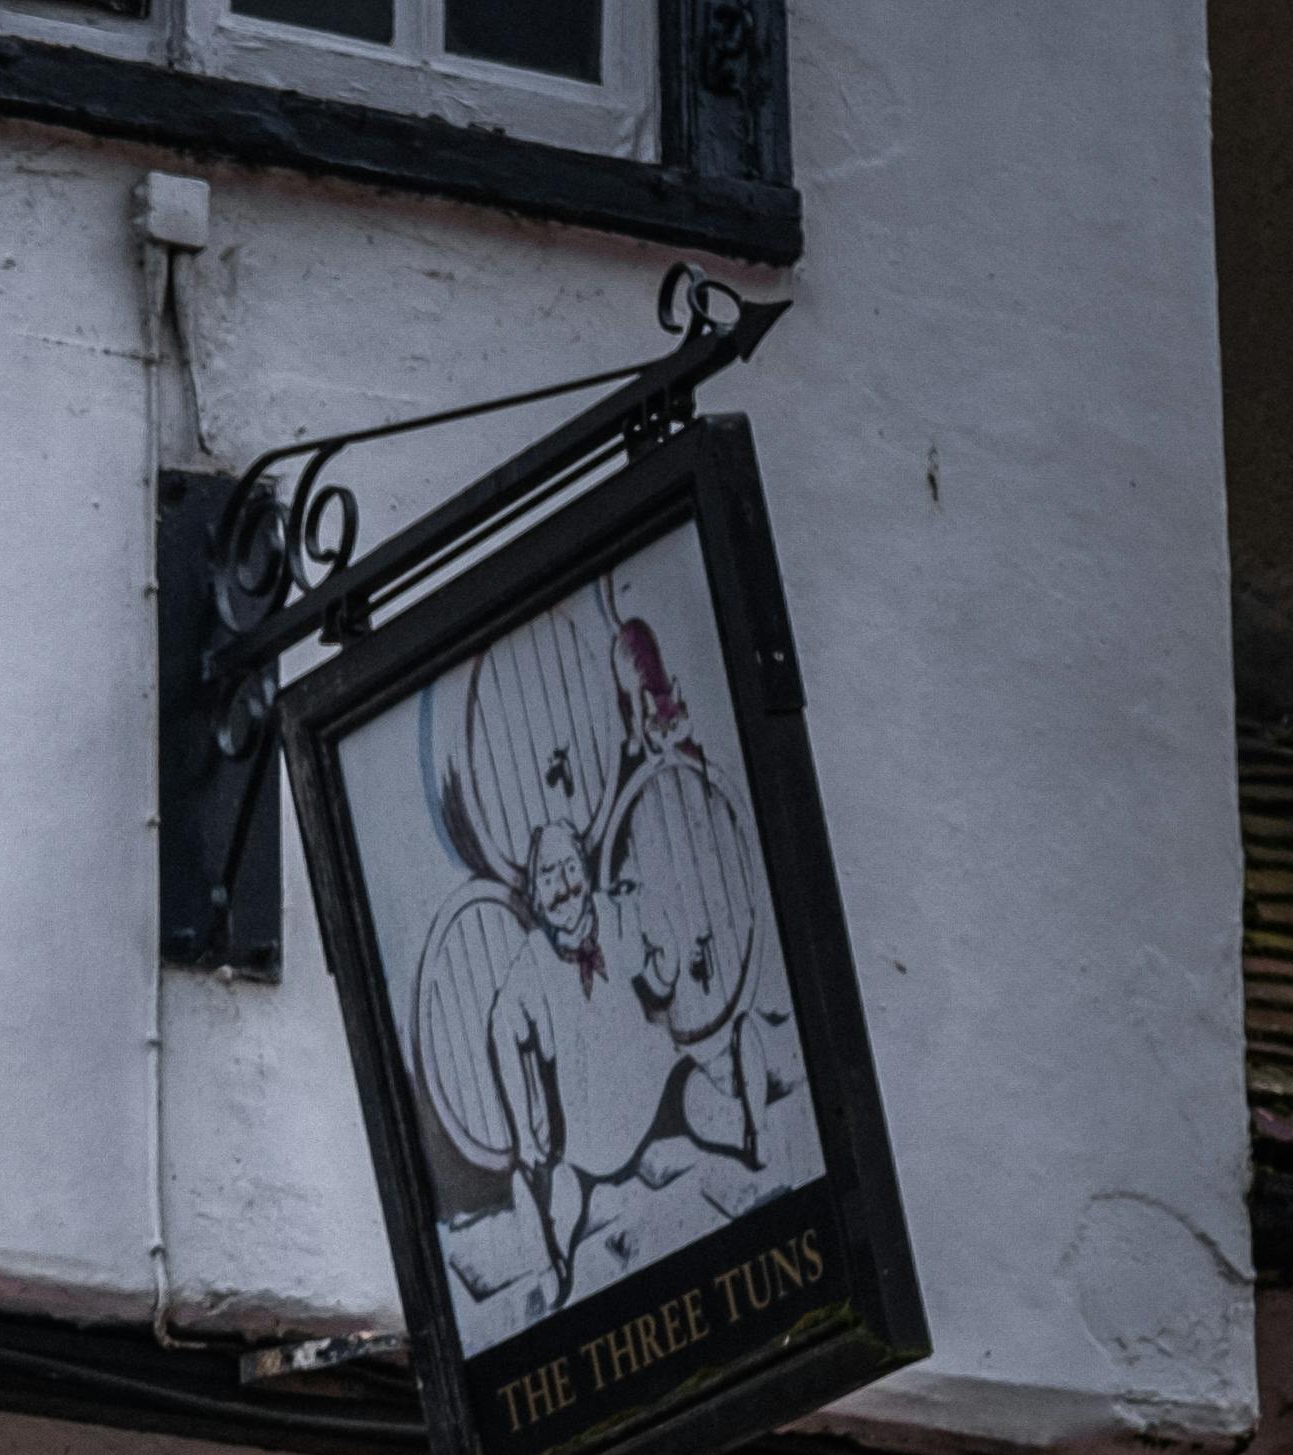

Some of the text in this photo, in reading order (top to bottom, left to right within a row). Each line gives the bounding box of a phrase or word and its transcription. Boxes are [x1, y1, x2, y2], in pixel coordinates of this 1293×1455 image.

[497, 1229, 824, 1432] THE THREE TUNS
